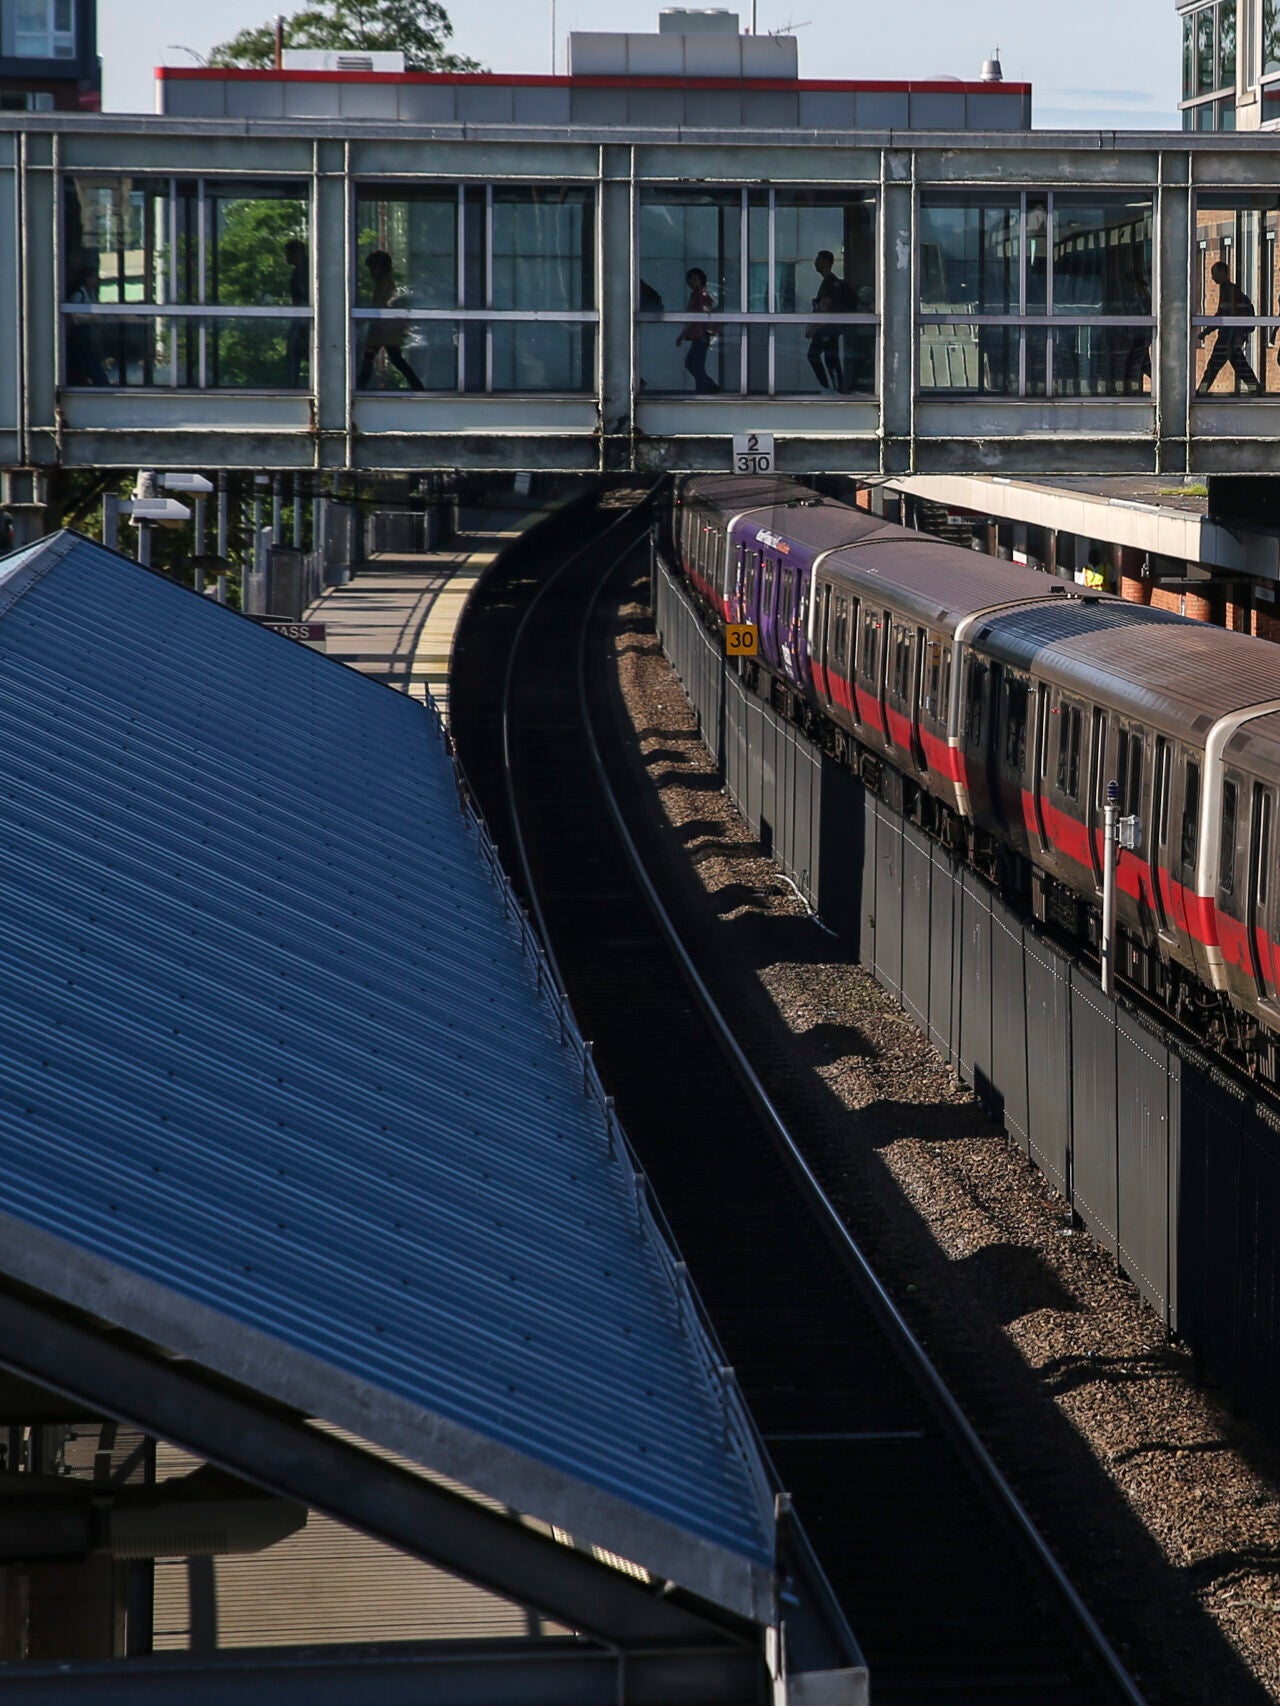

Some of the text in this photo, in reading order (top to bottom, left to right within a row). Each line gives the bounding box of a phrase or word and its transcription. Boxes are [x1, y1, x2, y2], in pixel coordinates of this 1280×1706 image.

[747, 434, 759, 451] 2
[738, 456, 770, 472] 310
[273, 626, 310, 639] ASS
[730, 631, 753, 648] 30
